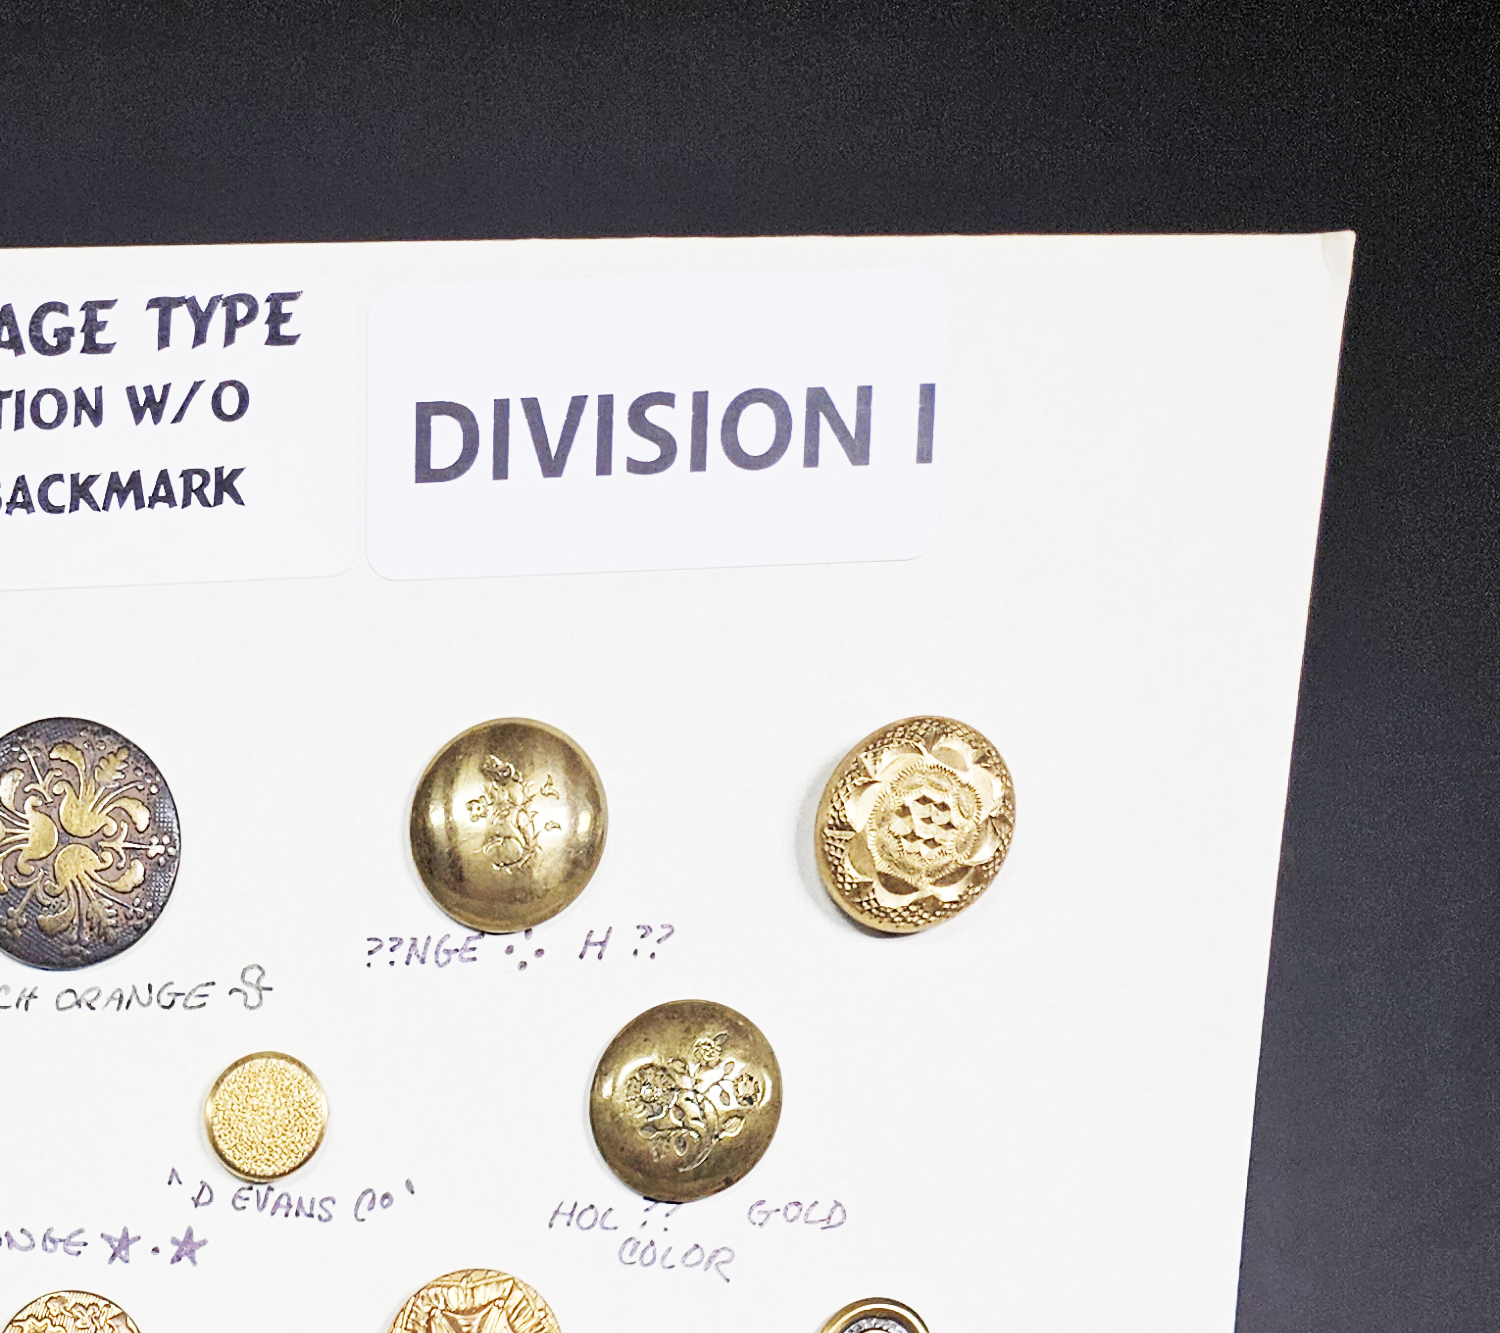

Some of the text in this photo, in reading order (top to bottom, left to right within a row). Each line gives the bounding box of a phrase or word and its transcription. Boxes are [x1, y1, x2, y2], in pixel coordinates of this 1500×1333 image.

[145, 290, 303, 352] TYPE
[125, 379, 250, 426] W/O
[414, 383, 936, 484] DIVISION I
[55, 981, 216, 1012] ORANGE
[230, 1184, 337, 1223] EVANS
[746, 1199, 848, 1230] GOLD
[617, 1235, 736, 1283] COLOR
